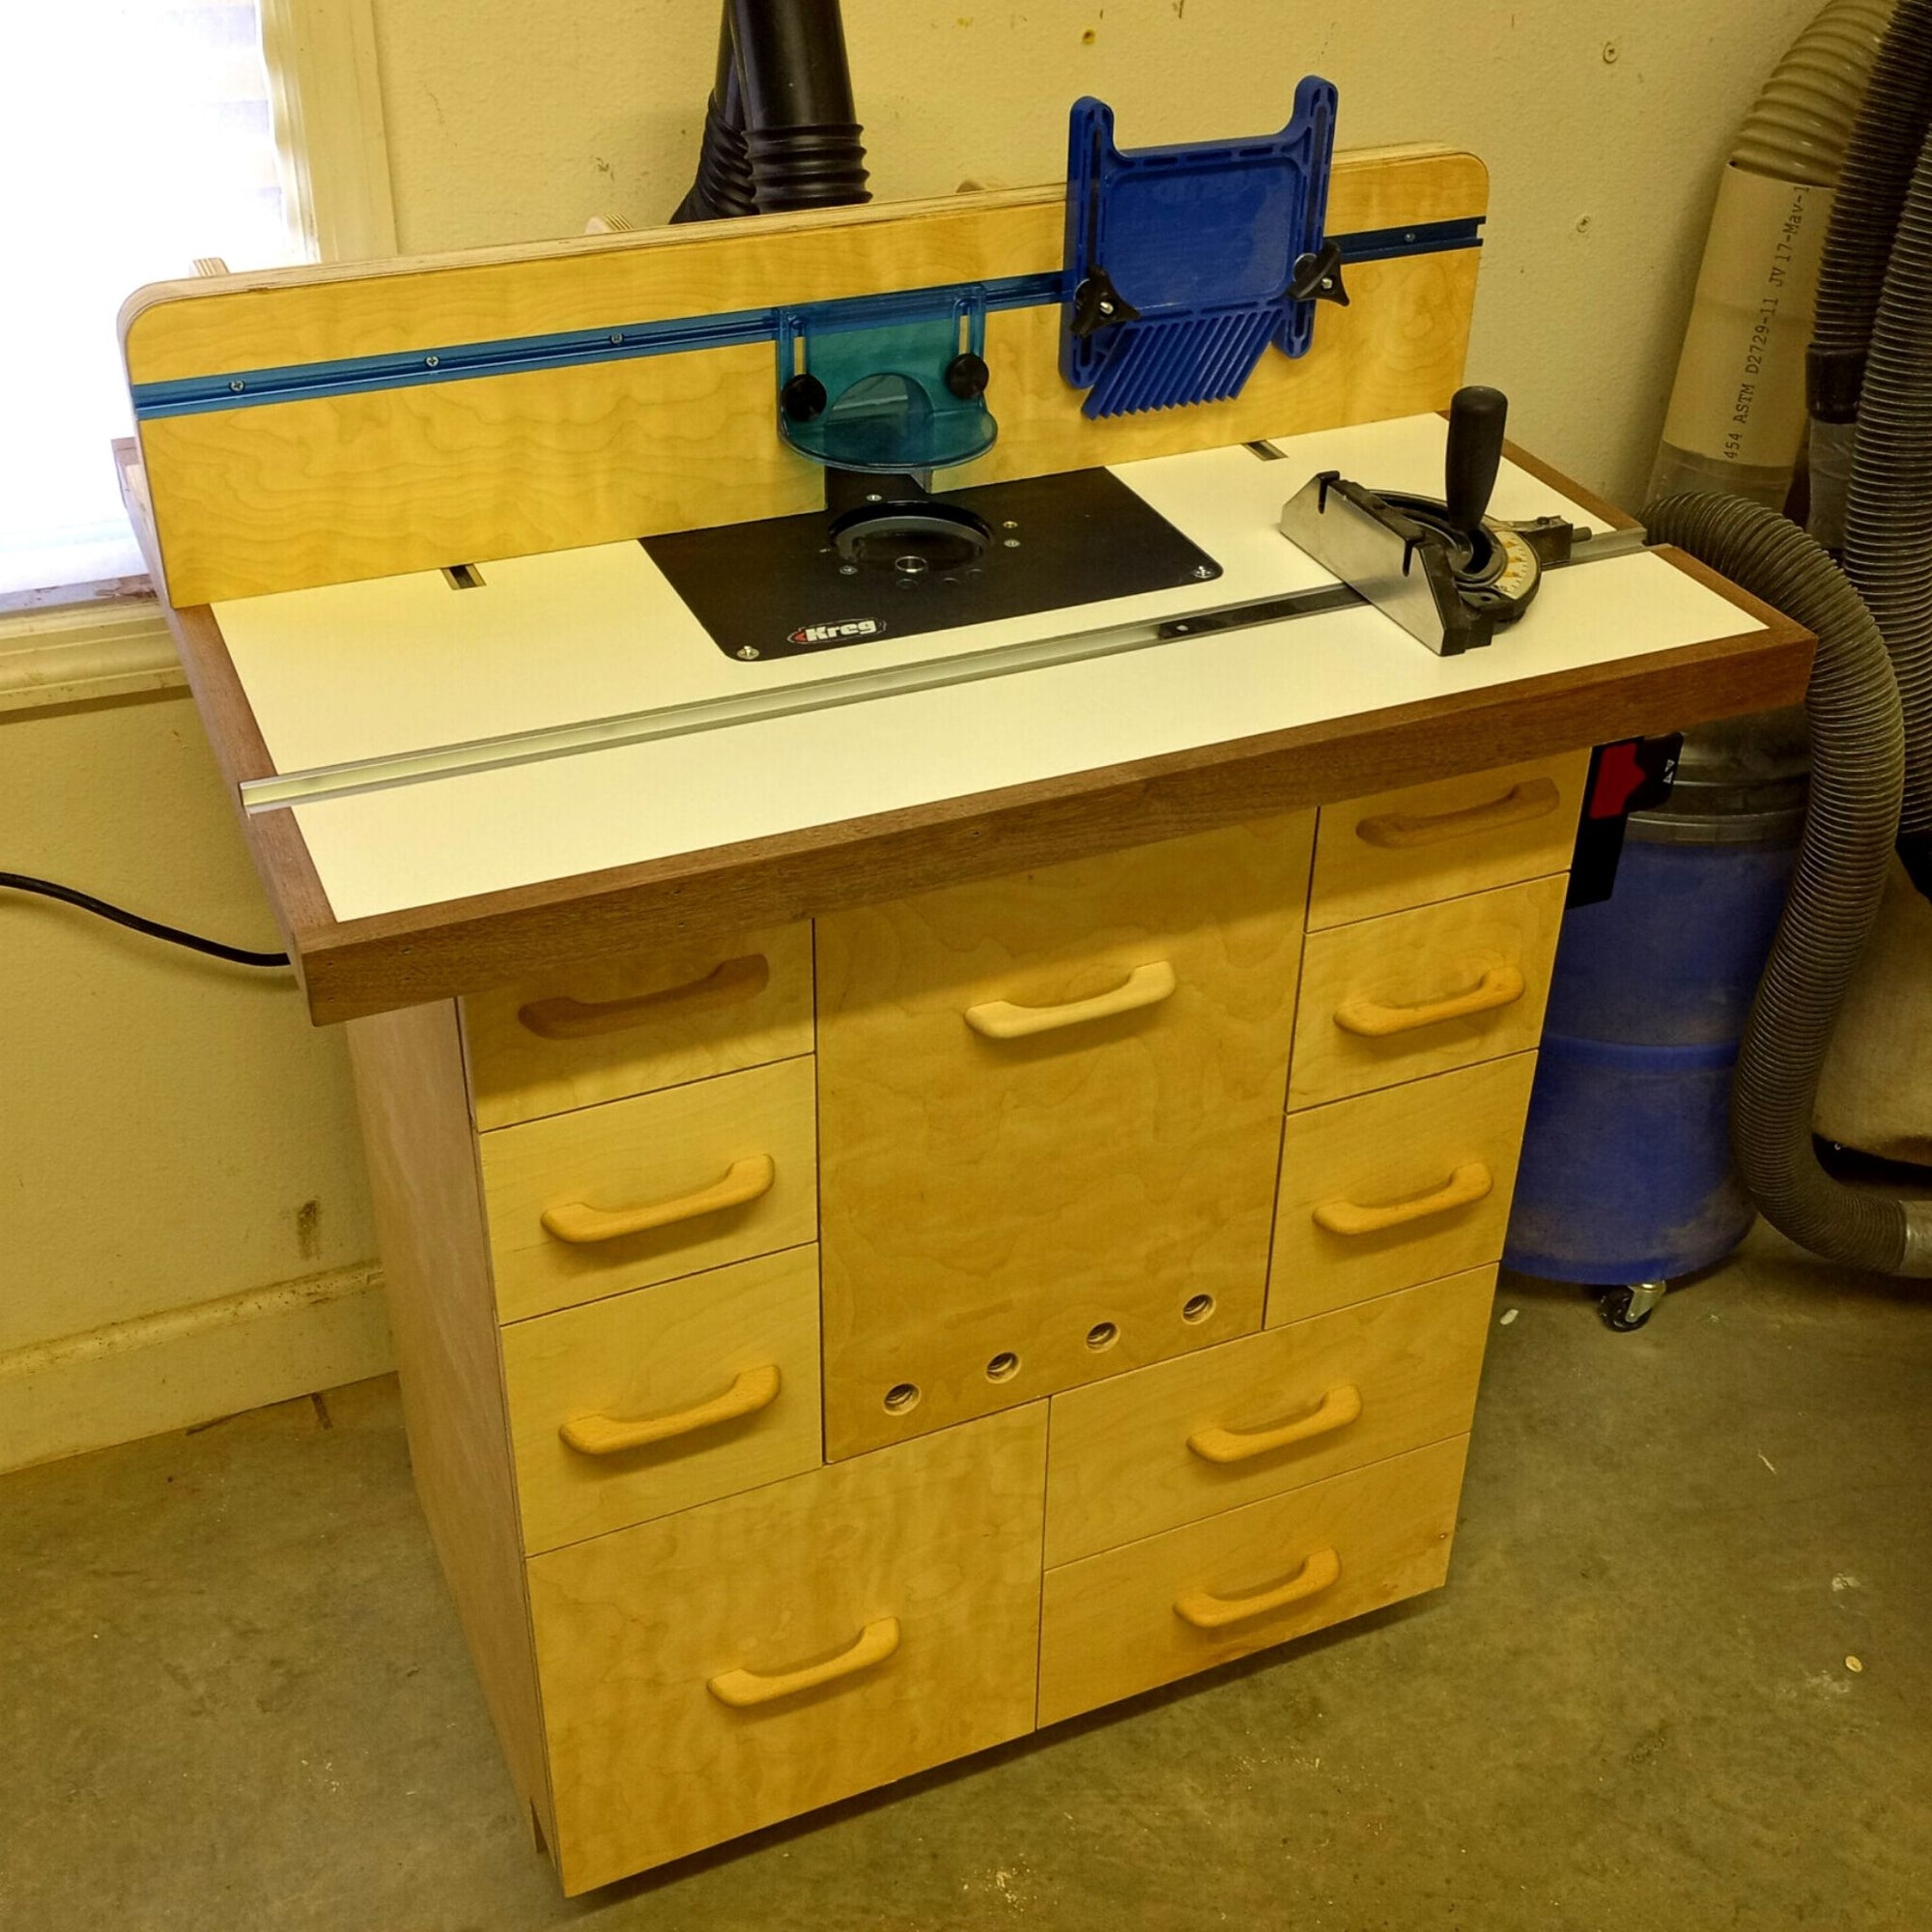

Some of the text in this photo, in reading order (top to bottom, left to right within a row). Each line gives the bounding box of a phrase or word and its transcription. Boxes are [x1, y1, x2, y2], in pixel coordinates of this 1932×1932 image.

[1745, 298, 1778, 374] D2729-11
[1732, 383, 1755, 424] ASTM
[1723, 432, 1743, 459] 454
[806, 620, 877, 642] Kreg
